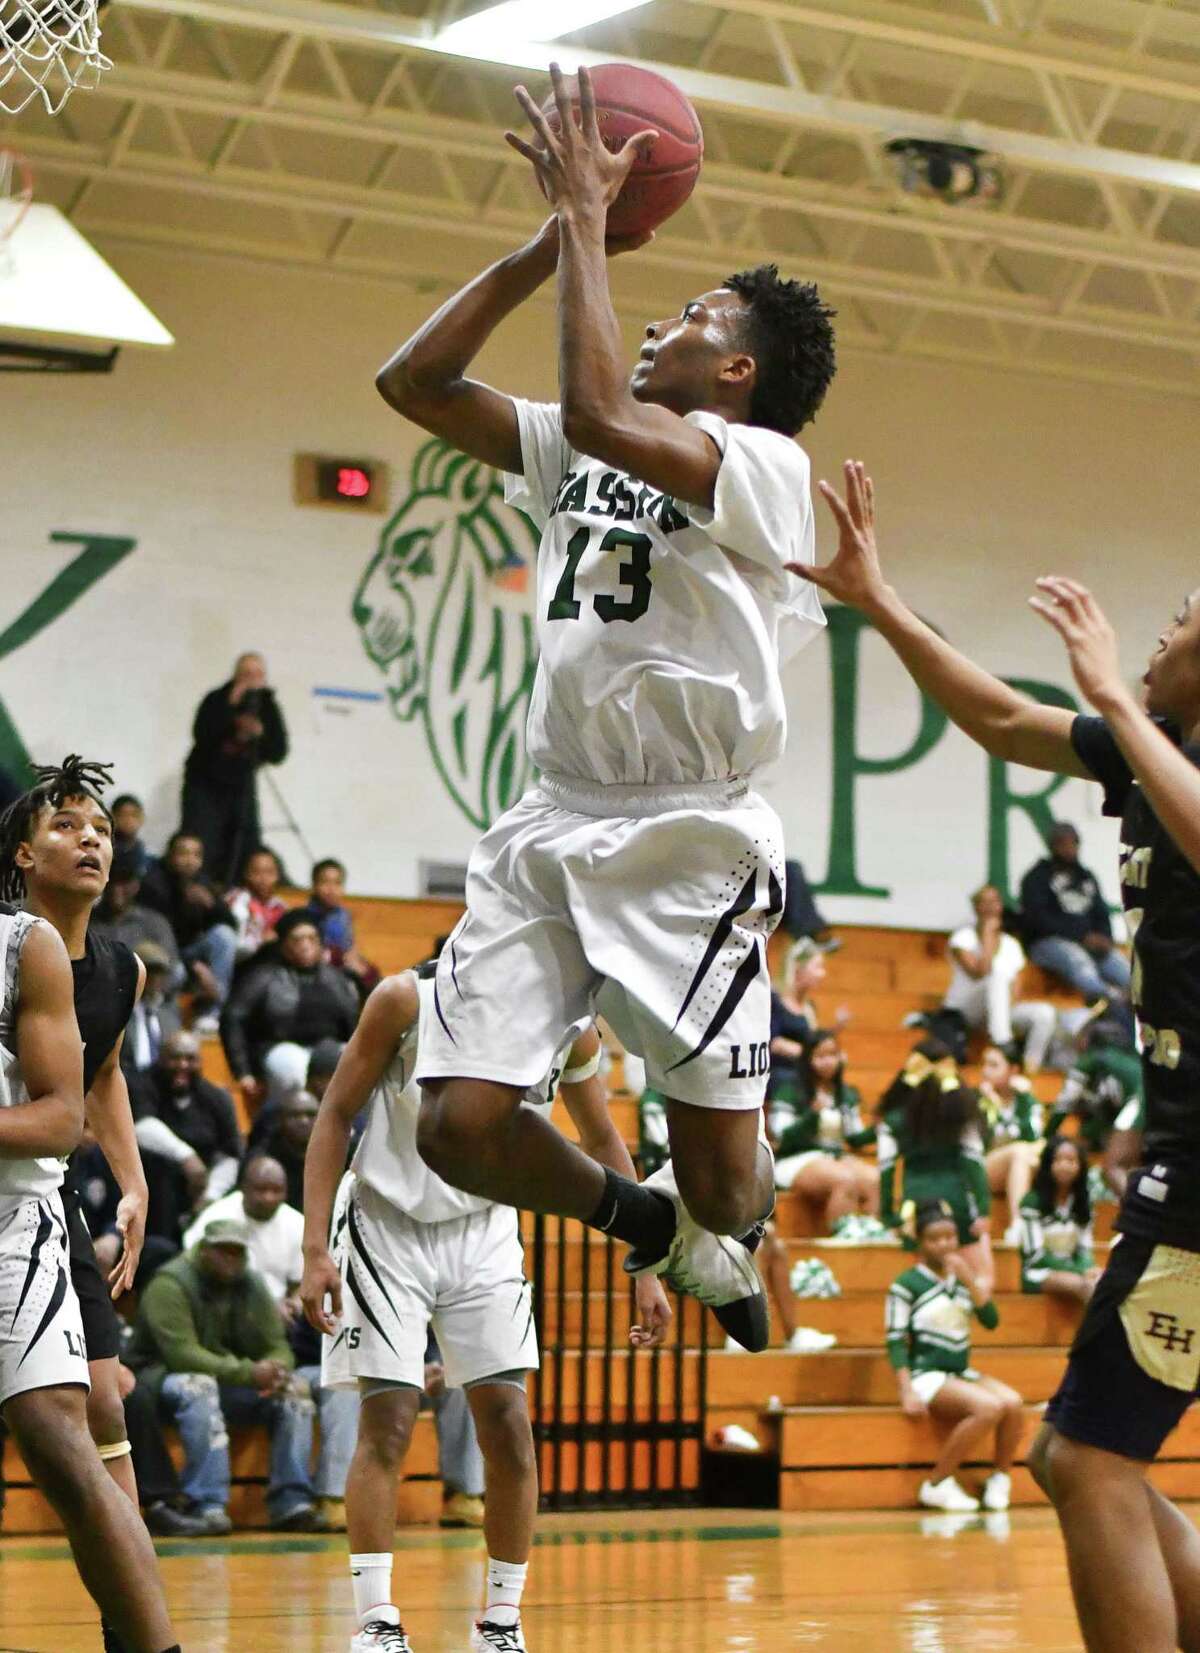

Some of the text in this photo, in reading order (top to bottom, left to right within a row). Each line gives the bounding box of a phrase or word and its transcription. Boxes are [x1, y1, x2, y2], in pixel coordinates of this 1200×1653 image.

[547, 526, 653, 624] 13
[728, 1042, 770, 1079] LIO
[1144, 1311, 1195, 1354] EH
